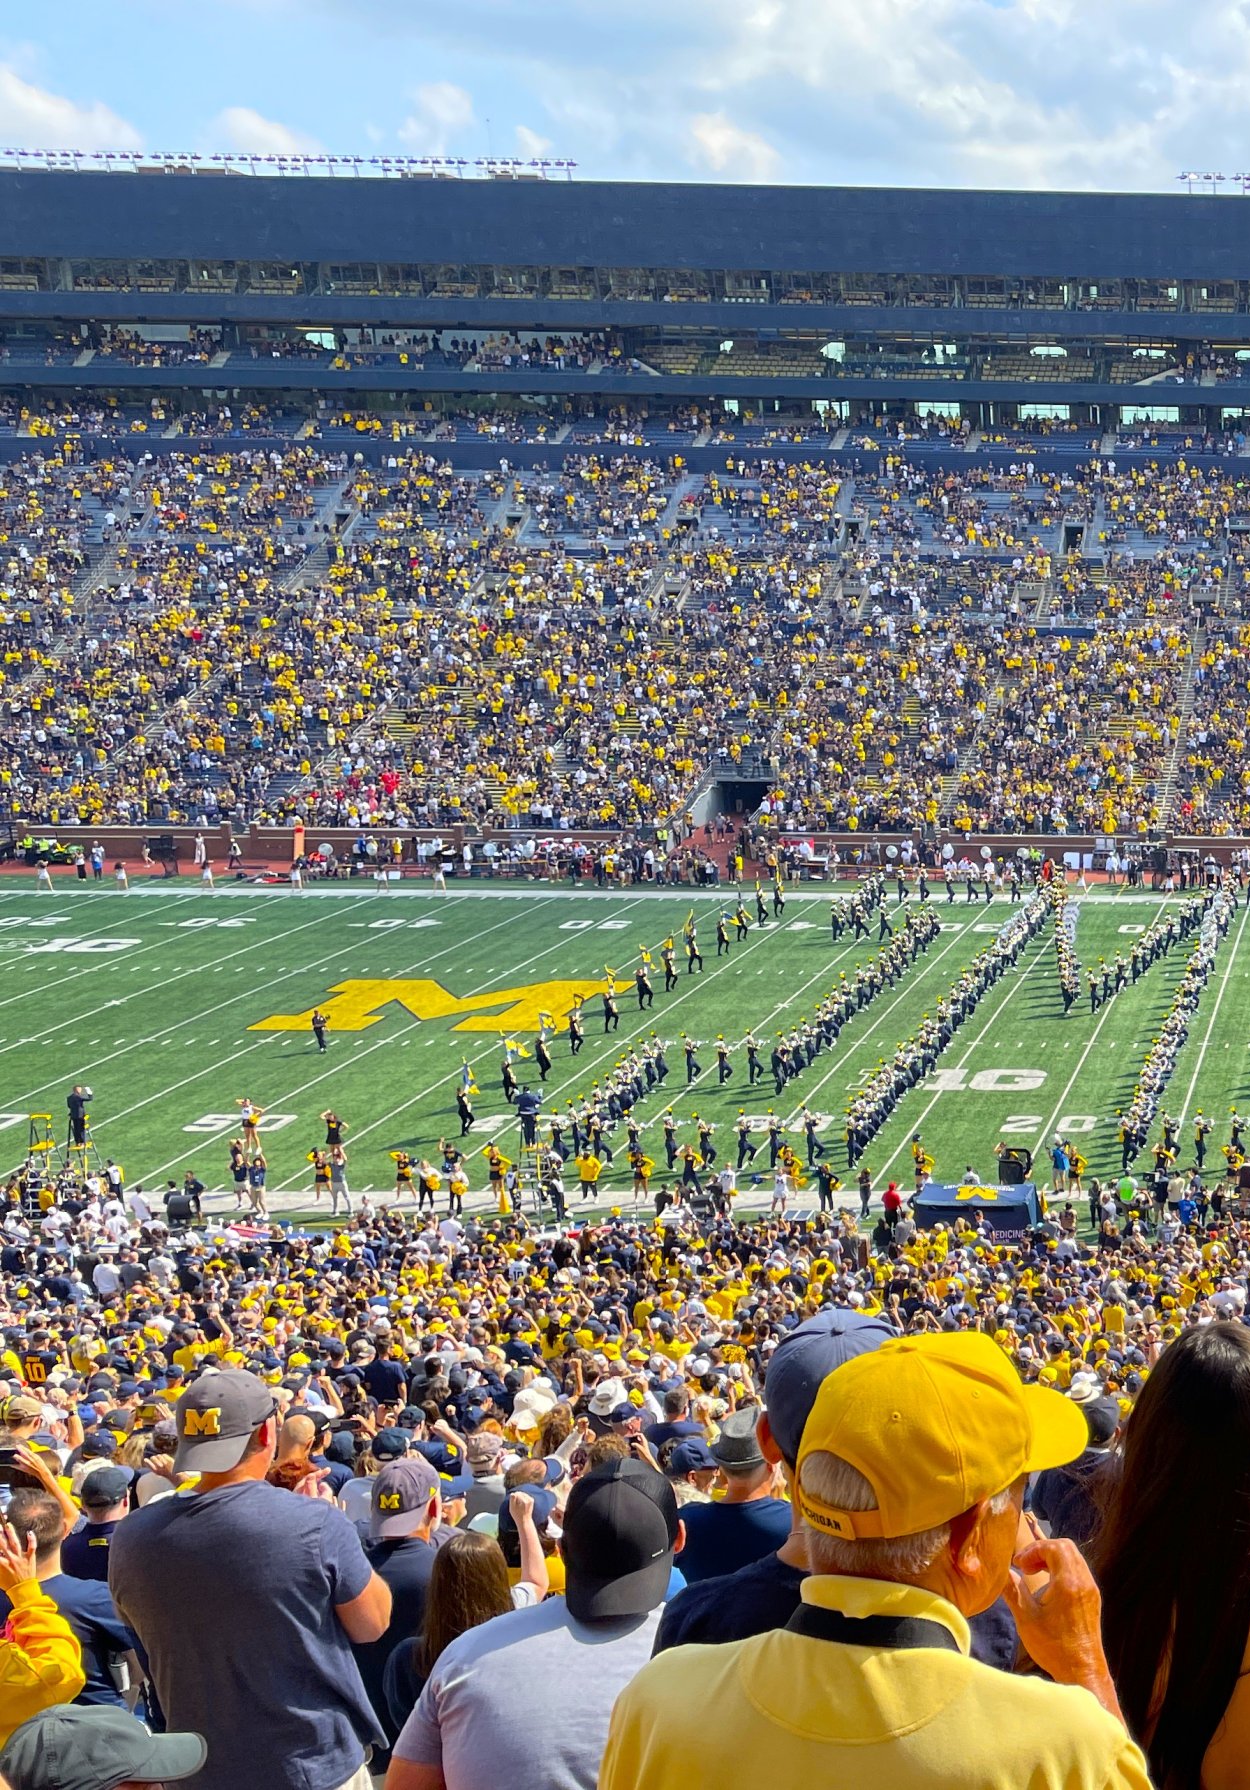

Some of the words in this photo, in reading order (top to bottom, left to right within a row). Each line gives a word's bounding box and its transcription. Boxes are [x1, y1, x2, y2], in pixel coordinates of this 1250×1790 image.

[247, 979, 637, 1032] M
[182, 1113, 299, 1132] 50
[999, 1115, 1098, 1133] 20
[25, 1362, 47, 1382] 10
[183, 1407, 221, 1436] M
[379, 1493, 400, 1509] M
[801, 1503, 842, 1531] CHIGAN
